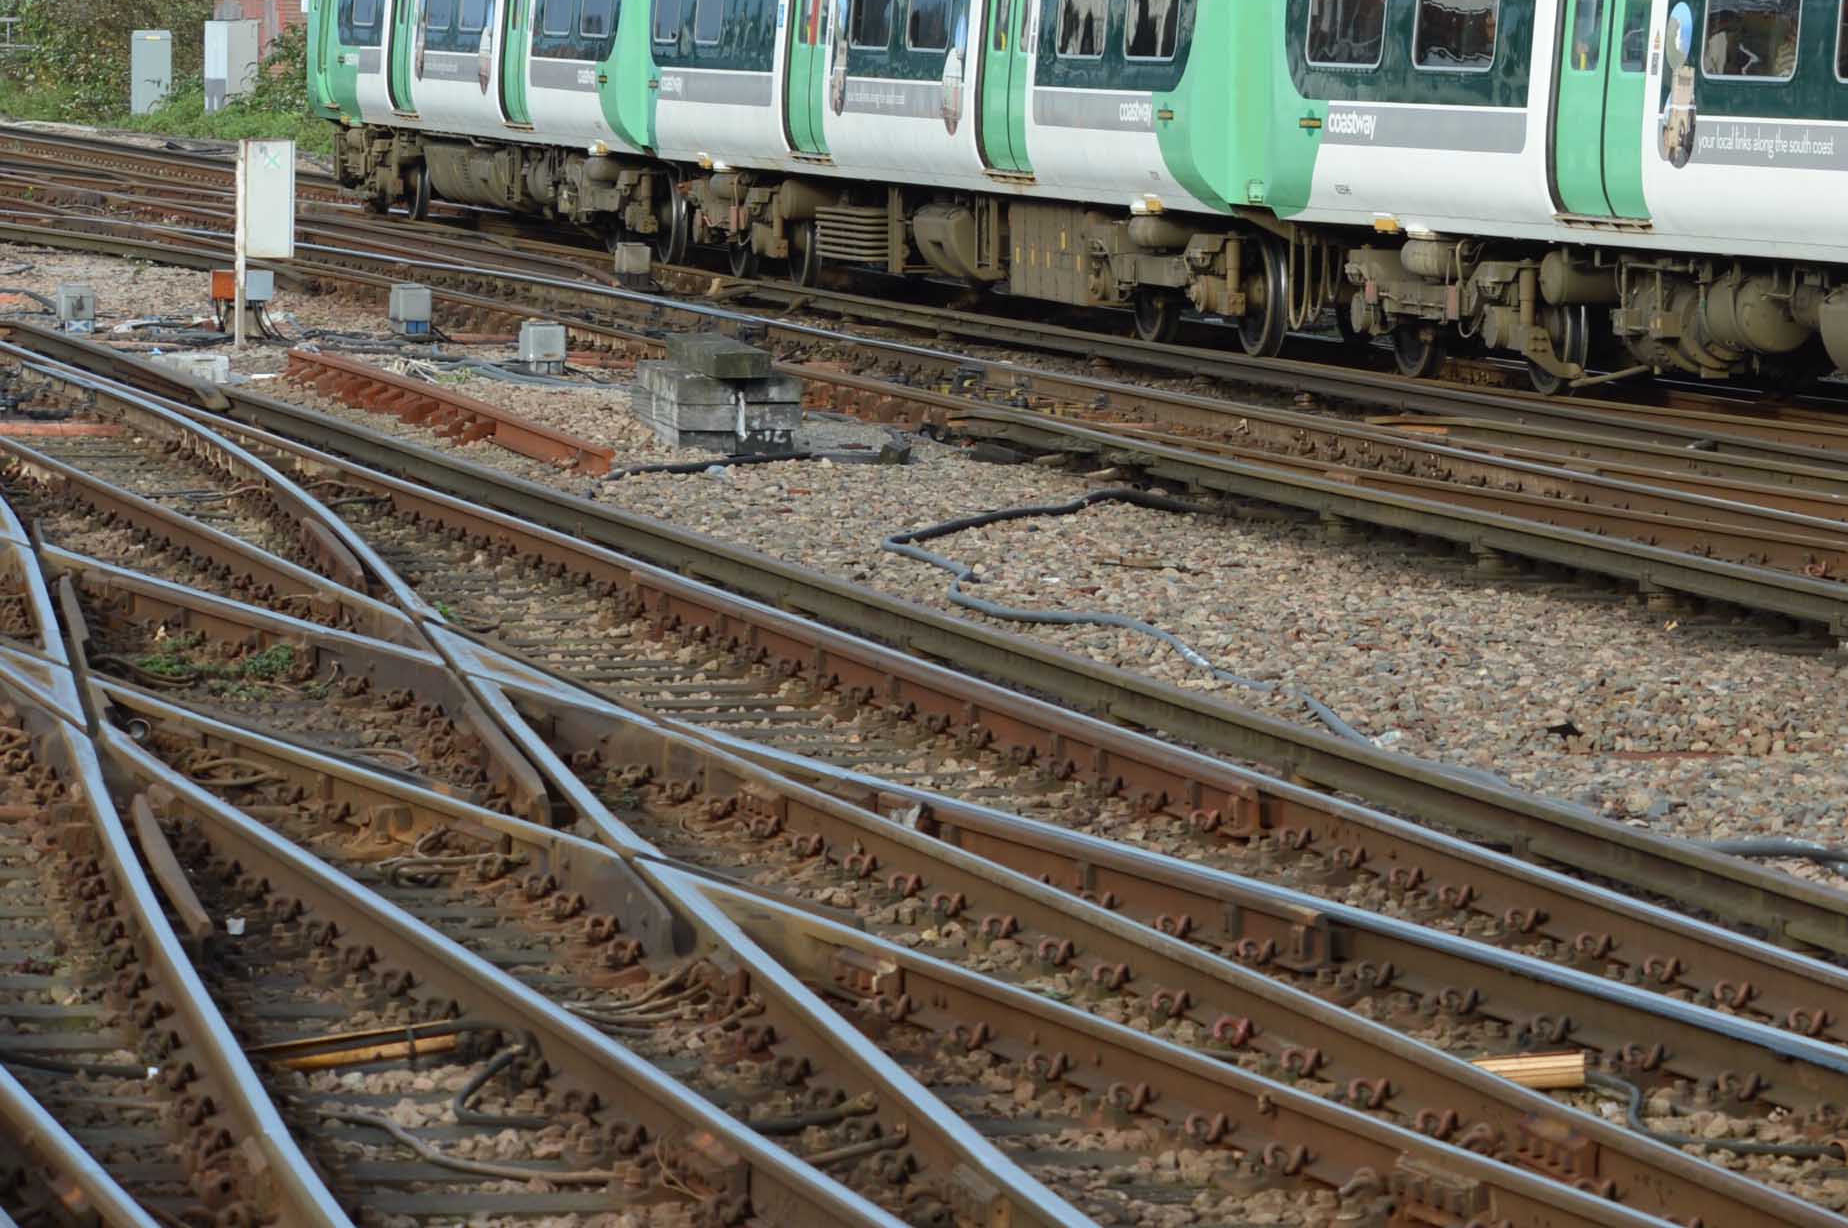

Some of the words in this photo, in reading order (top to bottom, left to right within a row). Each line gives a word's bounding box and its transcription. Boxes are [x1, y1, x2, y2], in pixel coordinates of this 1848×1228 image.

[1328, 111, 1377, 140] coastway
[1698, 134, 1715, 154] your
[1716, 124, 1734, 150] local
[1735, 125, 1752, 151] links
[1753, 126, 1774, 159] along
[1775, 126, 1788, 152] the
[1789, 128, 1811, 154] south
[1812, 134, 1834, 155] coast
